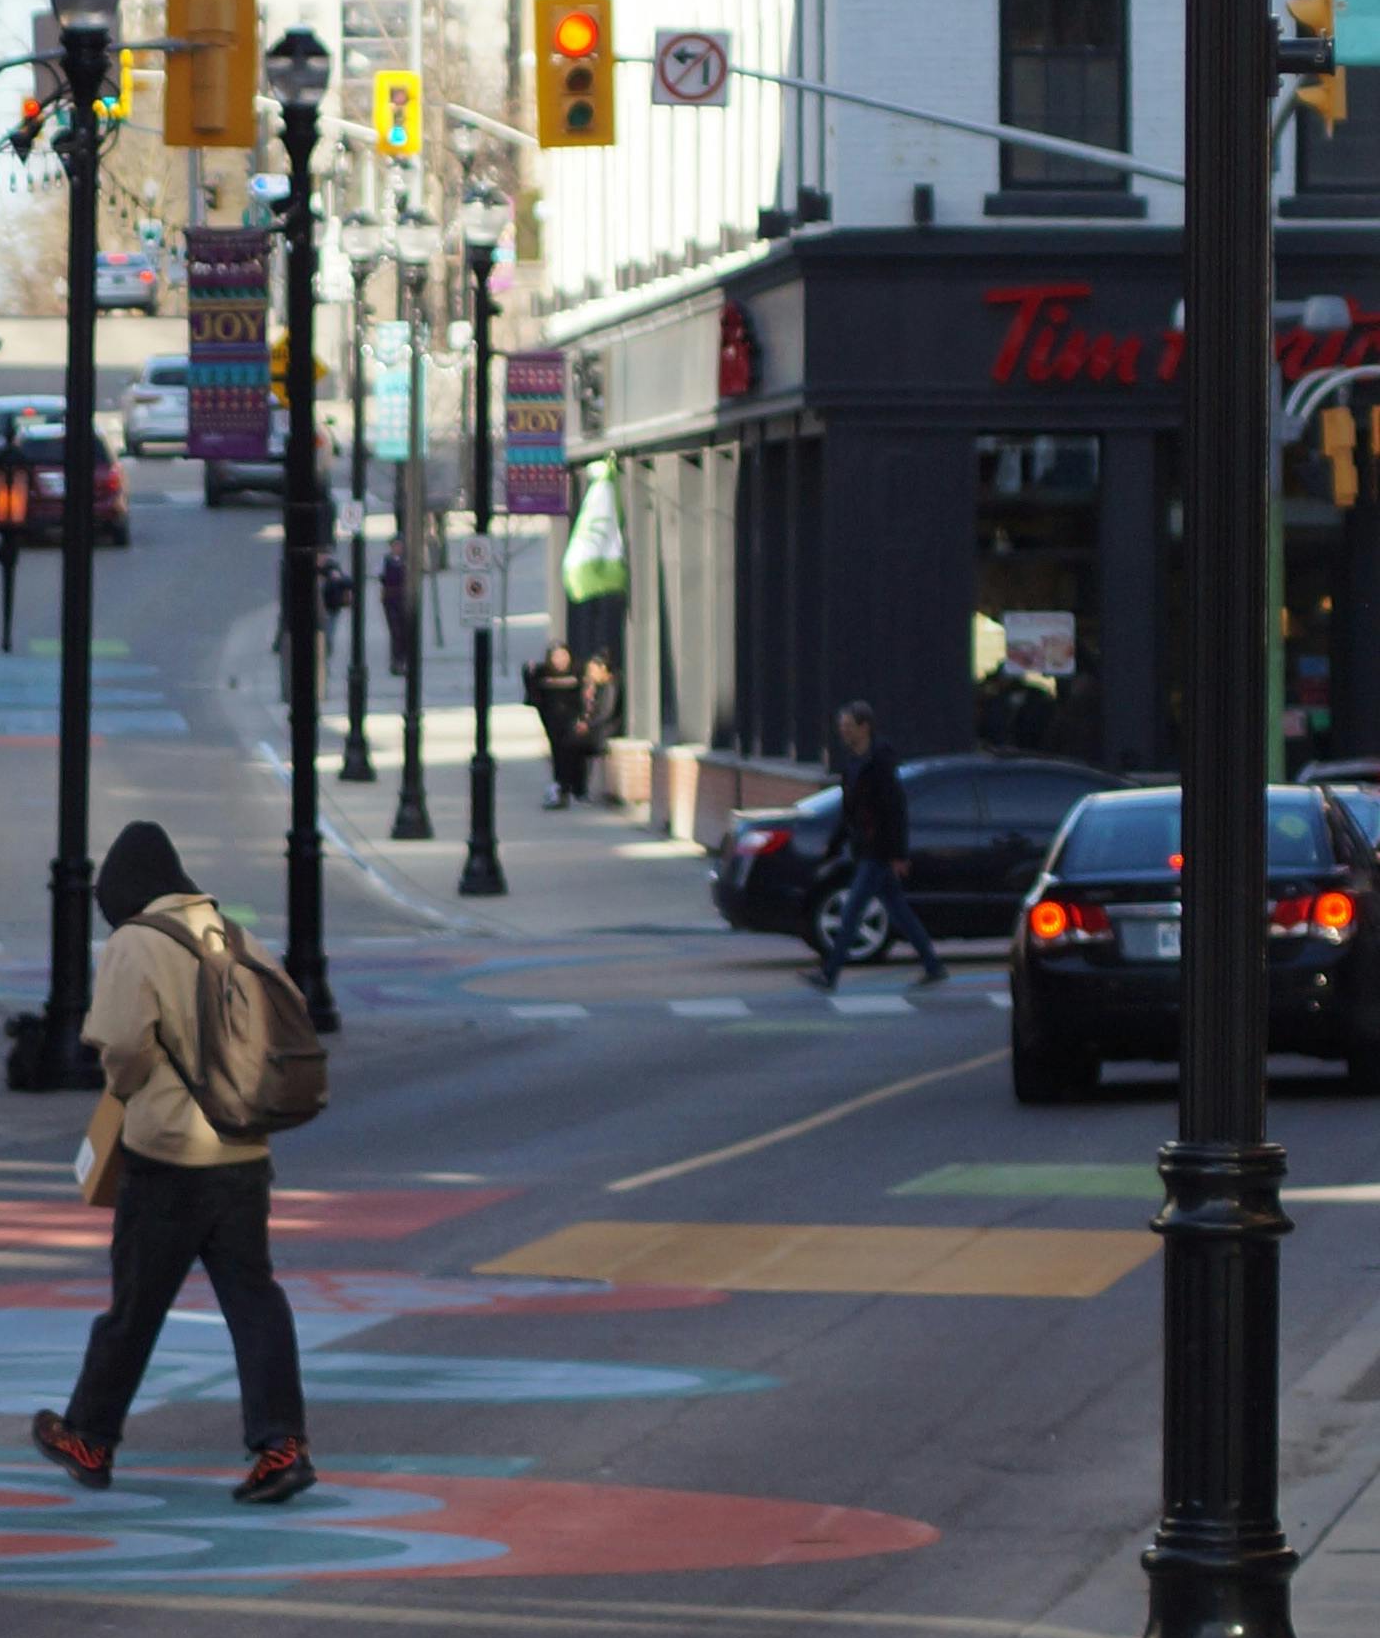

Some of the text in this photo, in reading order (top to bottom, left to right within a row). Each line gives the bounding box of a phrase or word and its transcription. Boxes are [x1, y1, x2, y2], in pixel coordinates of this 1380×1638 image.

[193, 312, 264, 342] JOY
[984, 283, 1142, 384] Tim
[509, 410, 563, 432] JOY
